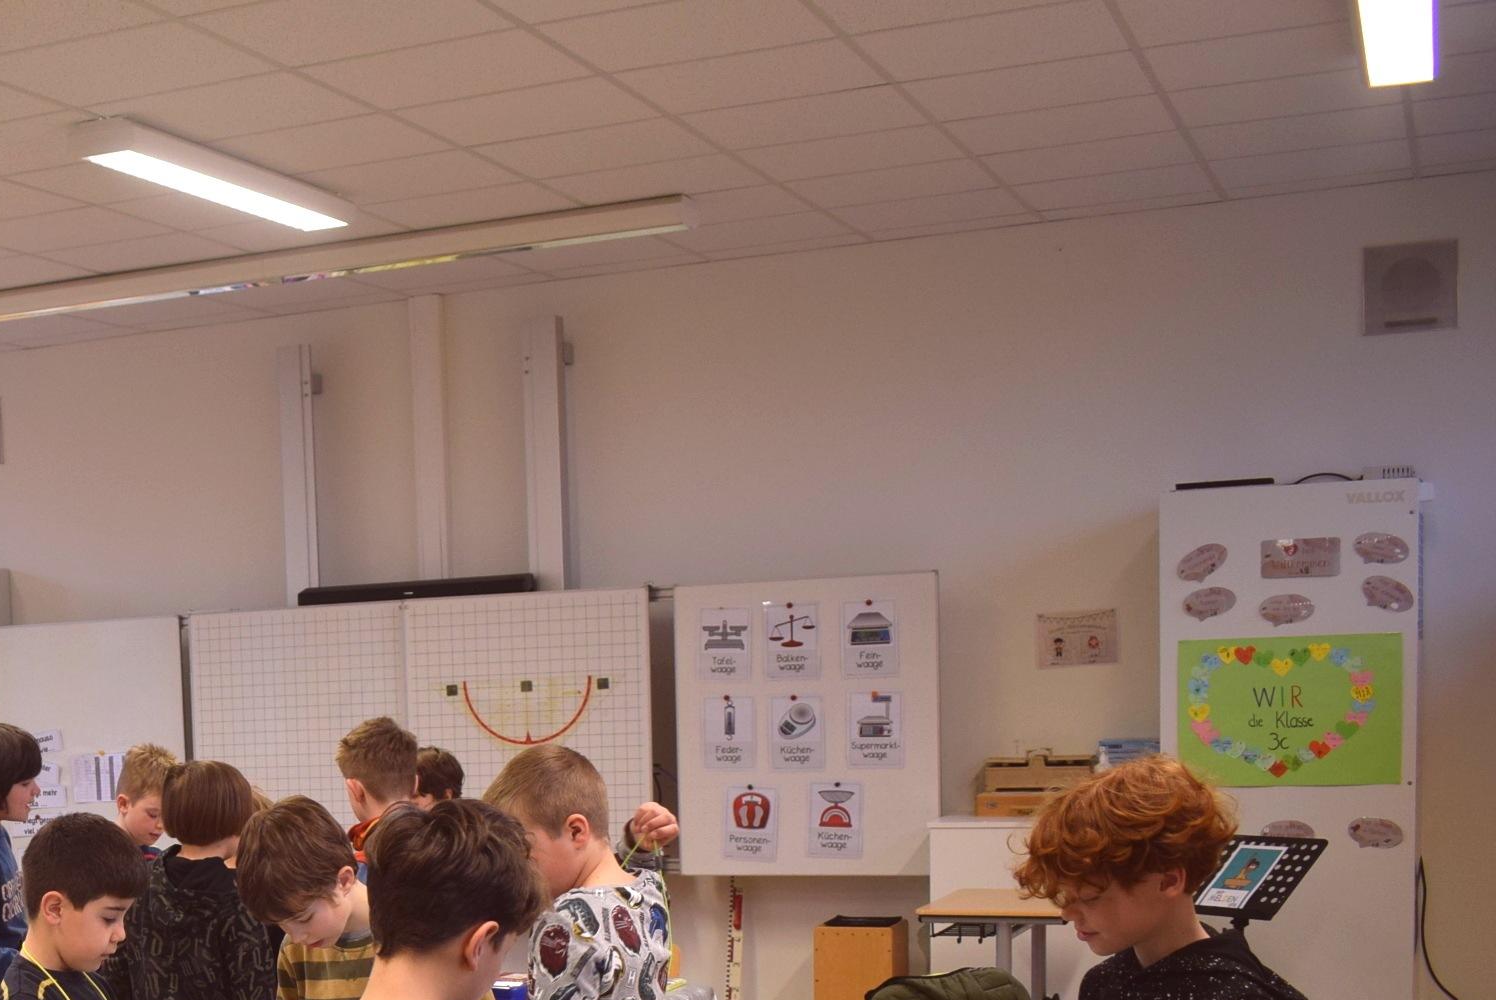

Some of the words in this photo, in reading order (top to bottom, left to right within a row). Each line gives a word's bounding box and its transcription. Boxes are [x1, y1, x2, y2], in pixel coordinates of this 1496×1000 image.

[1345, 490, 1406, 504] VALLOX
[776, 654, 808, 663] Balken-
[859, 650, 882, 660] Fein-
[712, 656, 736, 666] Tafel-
[856, 660, 884, 670] waage
[711, 666, 736, 675] waage
[779, 663, 805, 672] waage
[1253, 685, 1303, 708] WIR
[1248, 714, 1264, 728] die
[1275, 711, 1315, 728] Klasse
[851, 741, 901, 752] Supermarkt-
[1268, 732, 1289, 751] 3c
[715, 745, 743, 754] Feder-
[780, 745, 815, 755] Küchen-
[716, 755, 741, 764] waage
[784, 755, 810, 765] waage
[863, 752, 888, 761] waage
[729, 834, 772, 845] Personen-
[817, 832, 853, 841] Küchen-
[736, 844, 762, 854] waage
[820, 841, 847, 851] waage
